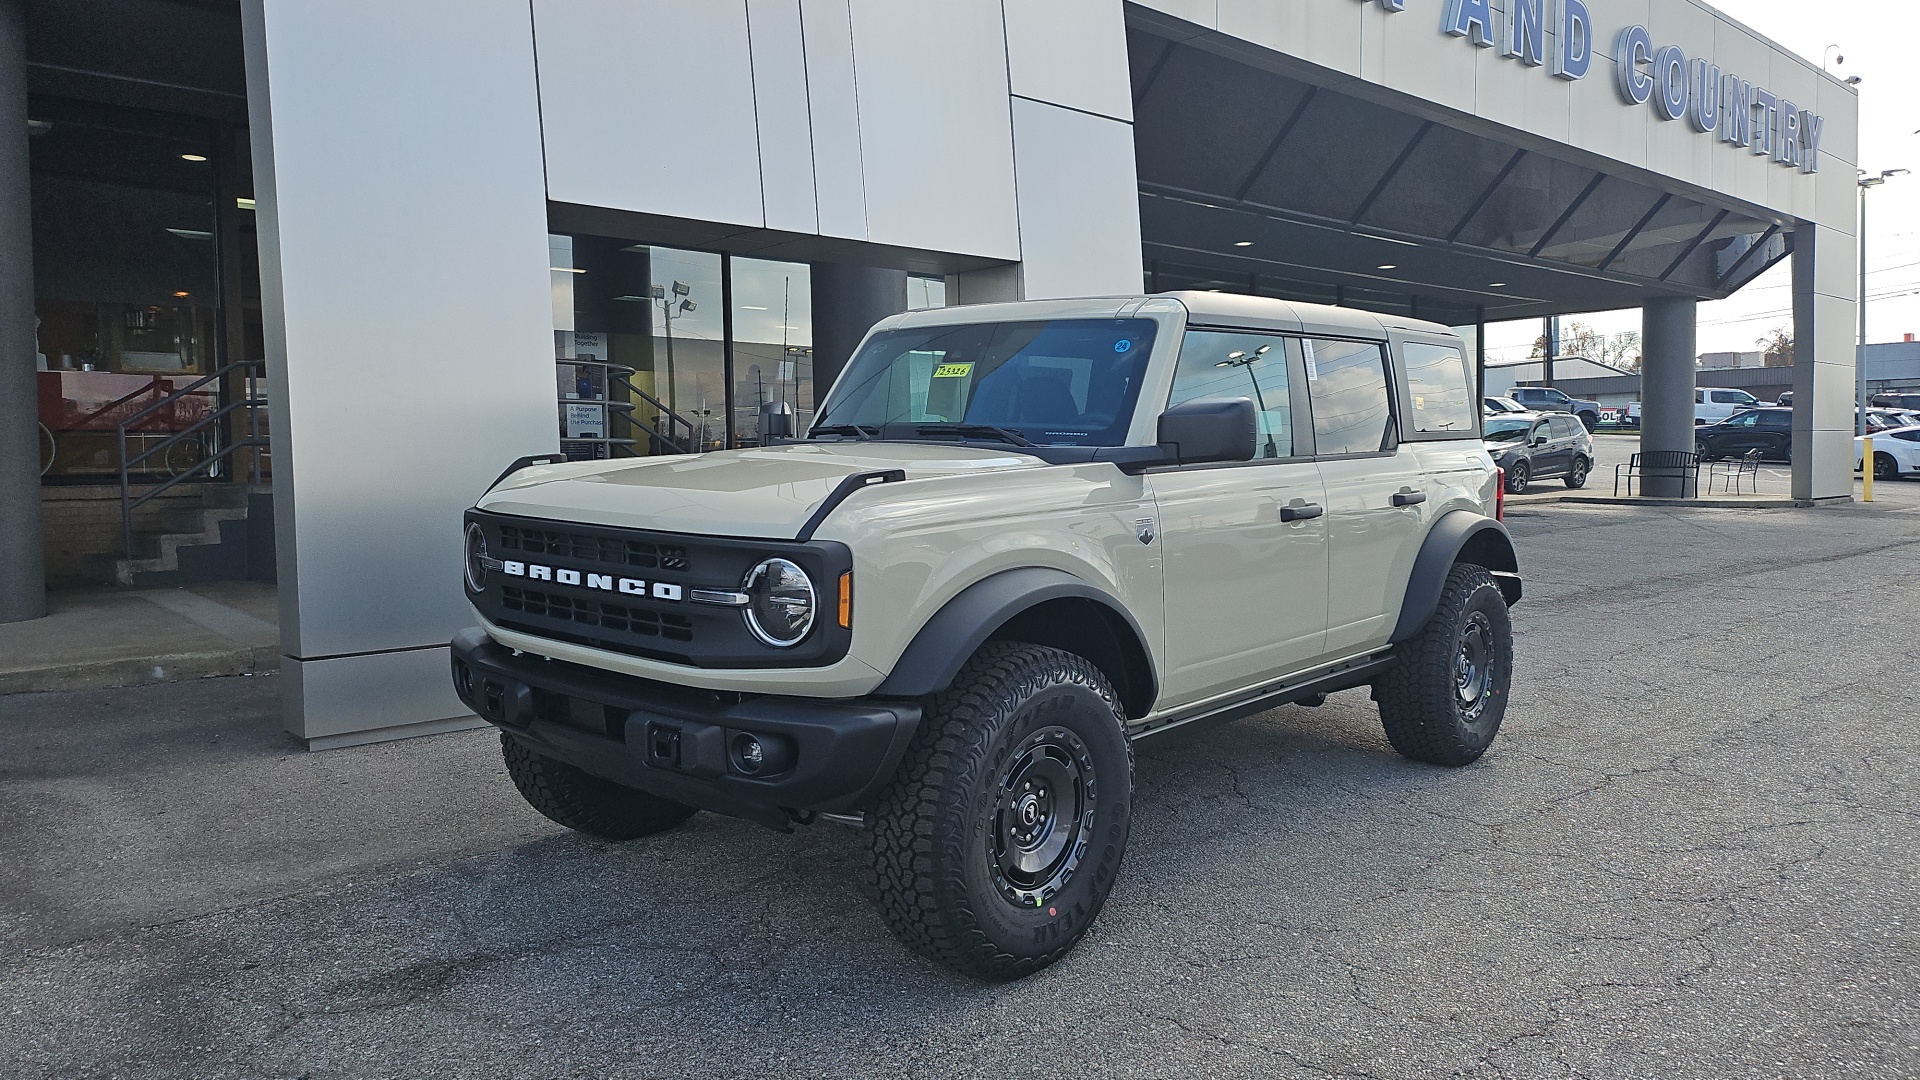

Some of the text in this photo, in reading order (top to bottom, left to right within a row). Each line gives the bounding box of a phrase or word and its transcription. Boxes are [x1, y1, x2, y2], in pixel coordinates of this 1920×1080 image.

[1446, 0, 1824, 174] AND COUNTRY
[575, 333, 597, 341] Building
[503, 560, 682, 601] BRONCO
